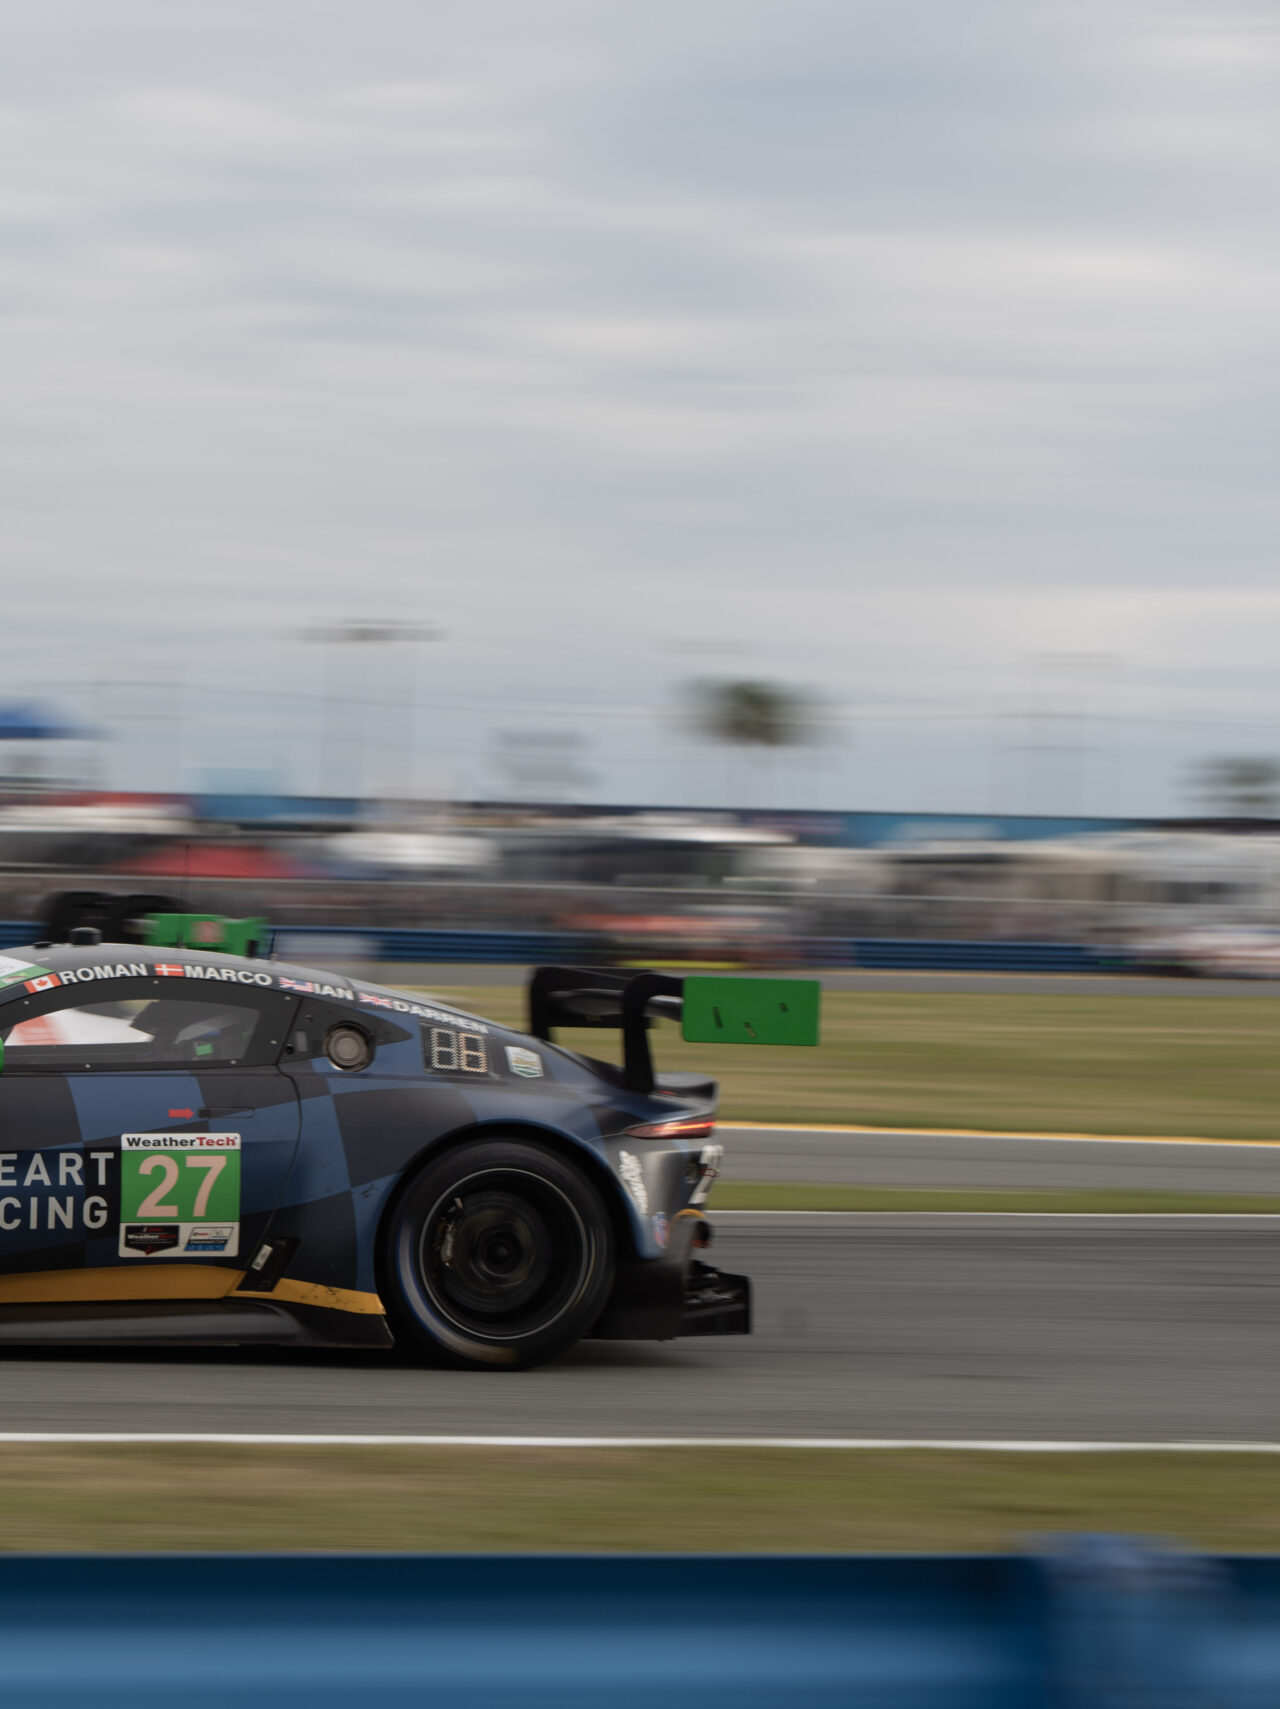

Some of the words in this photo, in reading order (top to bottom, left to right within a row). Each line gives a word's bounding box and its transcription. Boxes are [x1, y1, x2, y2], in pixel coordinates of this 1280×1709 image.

[60, 963, 148, 985] ROMAN
[184, 965, 273, 986] MARCO
[313, 983, 355, 1001] IAN
[392, 1000, 488, 1034] DARREN
[126, 1136, 236, 1147] WeatherTech
[136, 1154, 227, 1217] 27
